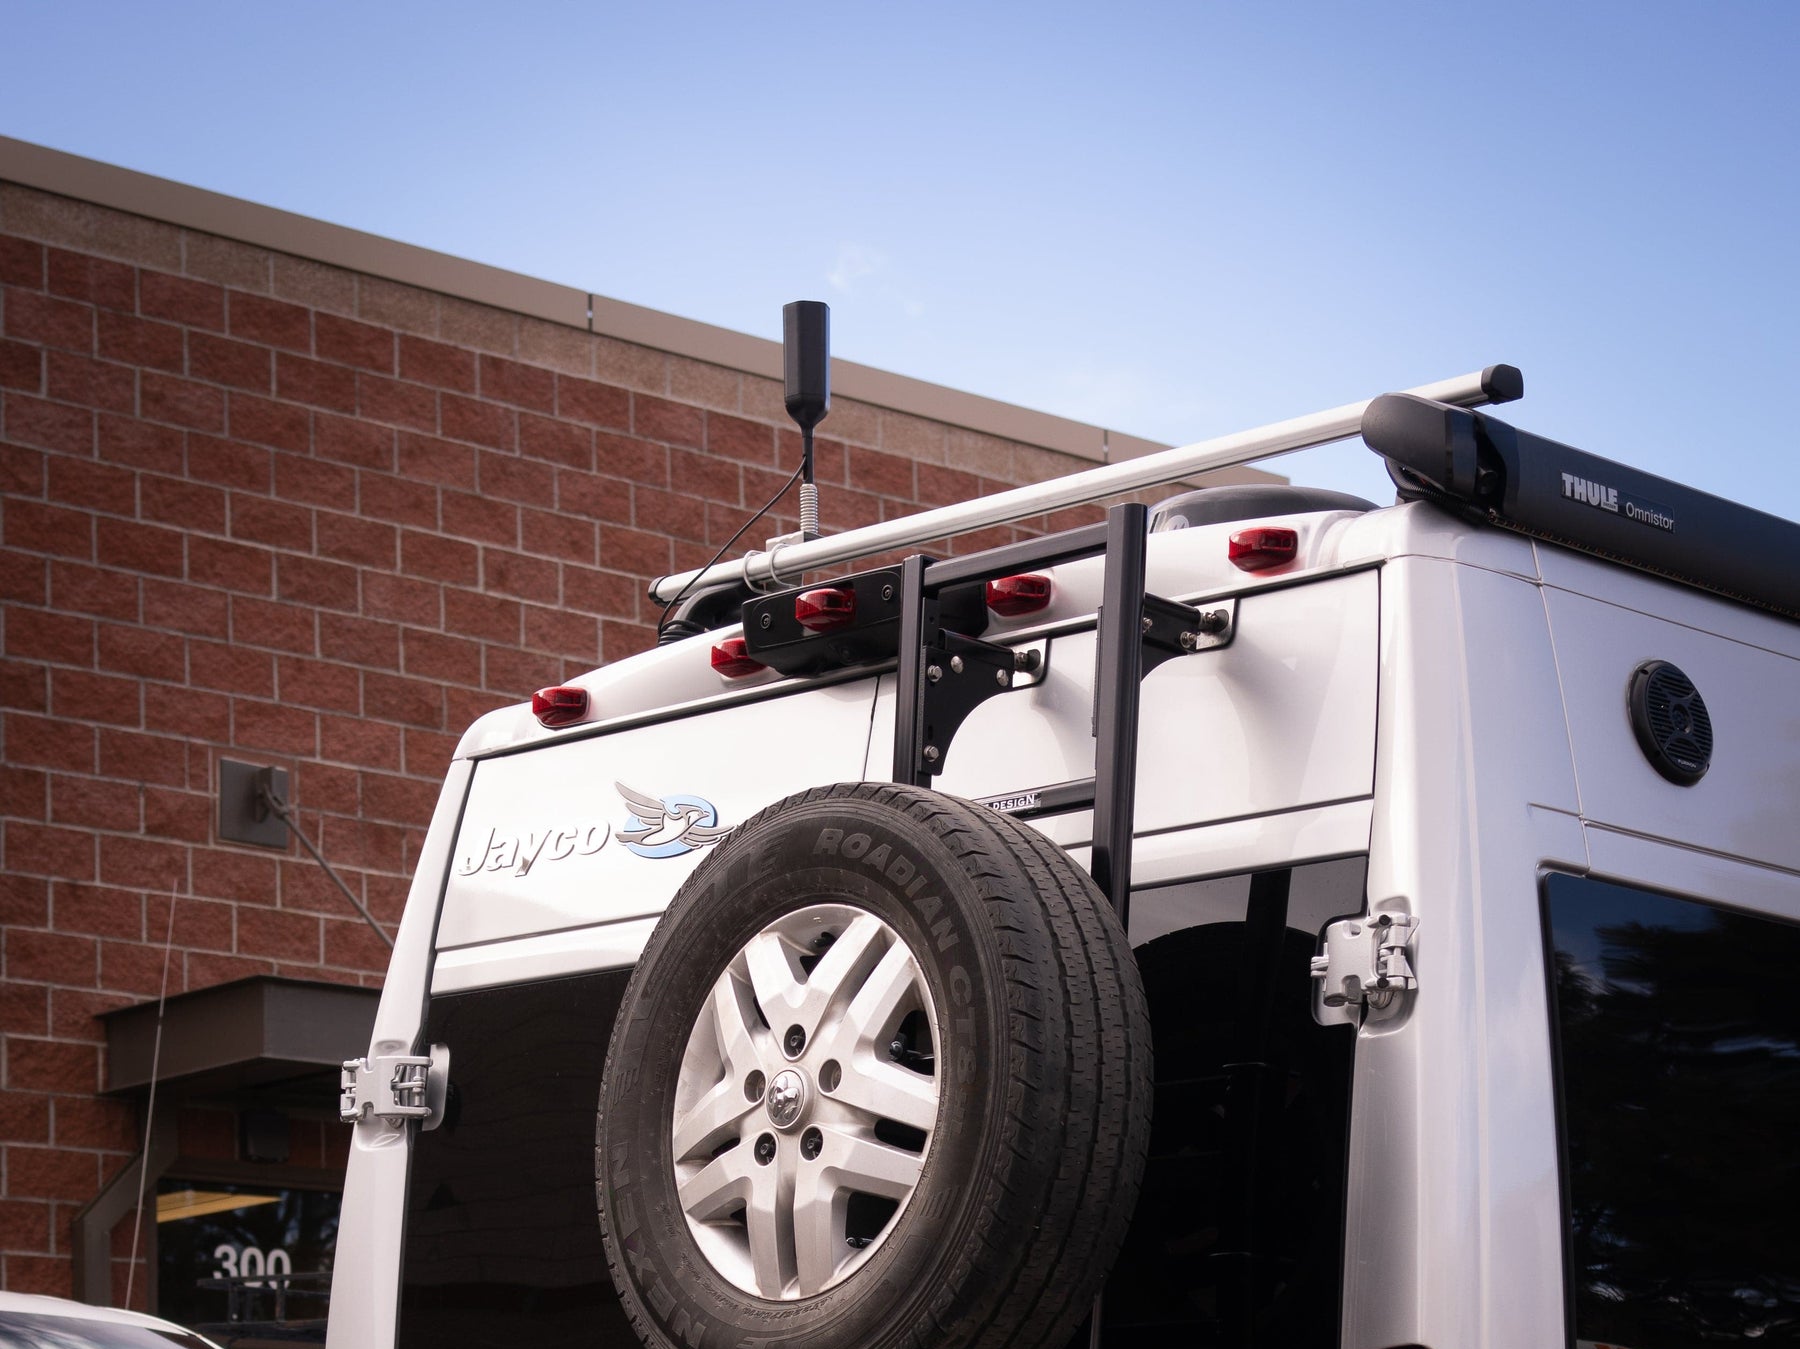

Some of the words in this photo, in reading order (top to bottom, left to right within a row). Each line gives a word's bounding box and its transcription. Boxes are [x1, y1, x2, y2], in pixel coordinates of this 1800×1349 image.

[1562, 472, 1618, 509] THULE
[1625, 502, 1674, 530] Omnistor
[993, 793, 1035, 810] DESIGN
[457, 819, 610, 878] Jayco
[812, 828, 960, 952] ROADIAN
[950, 965, 977, 1085] CT8
[213, 1244, 291, 1290] 300
[608, 1141, 706, 1349] NEXEN
